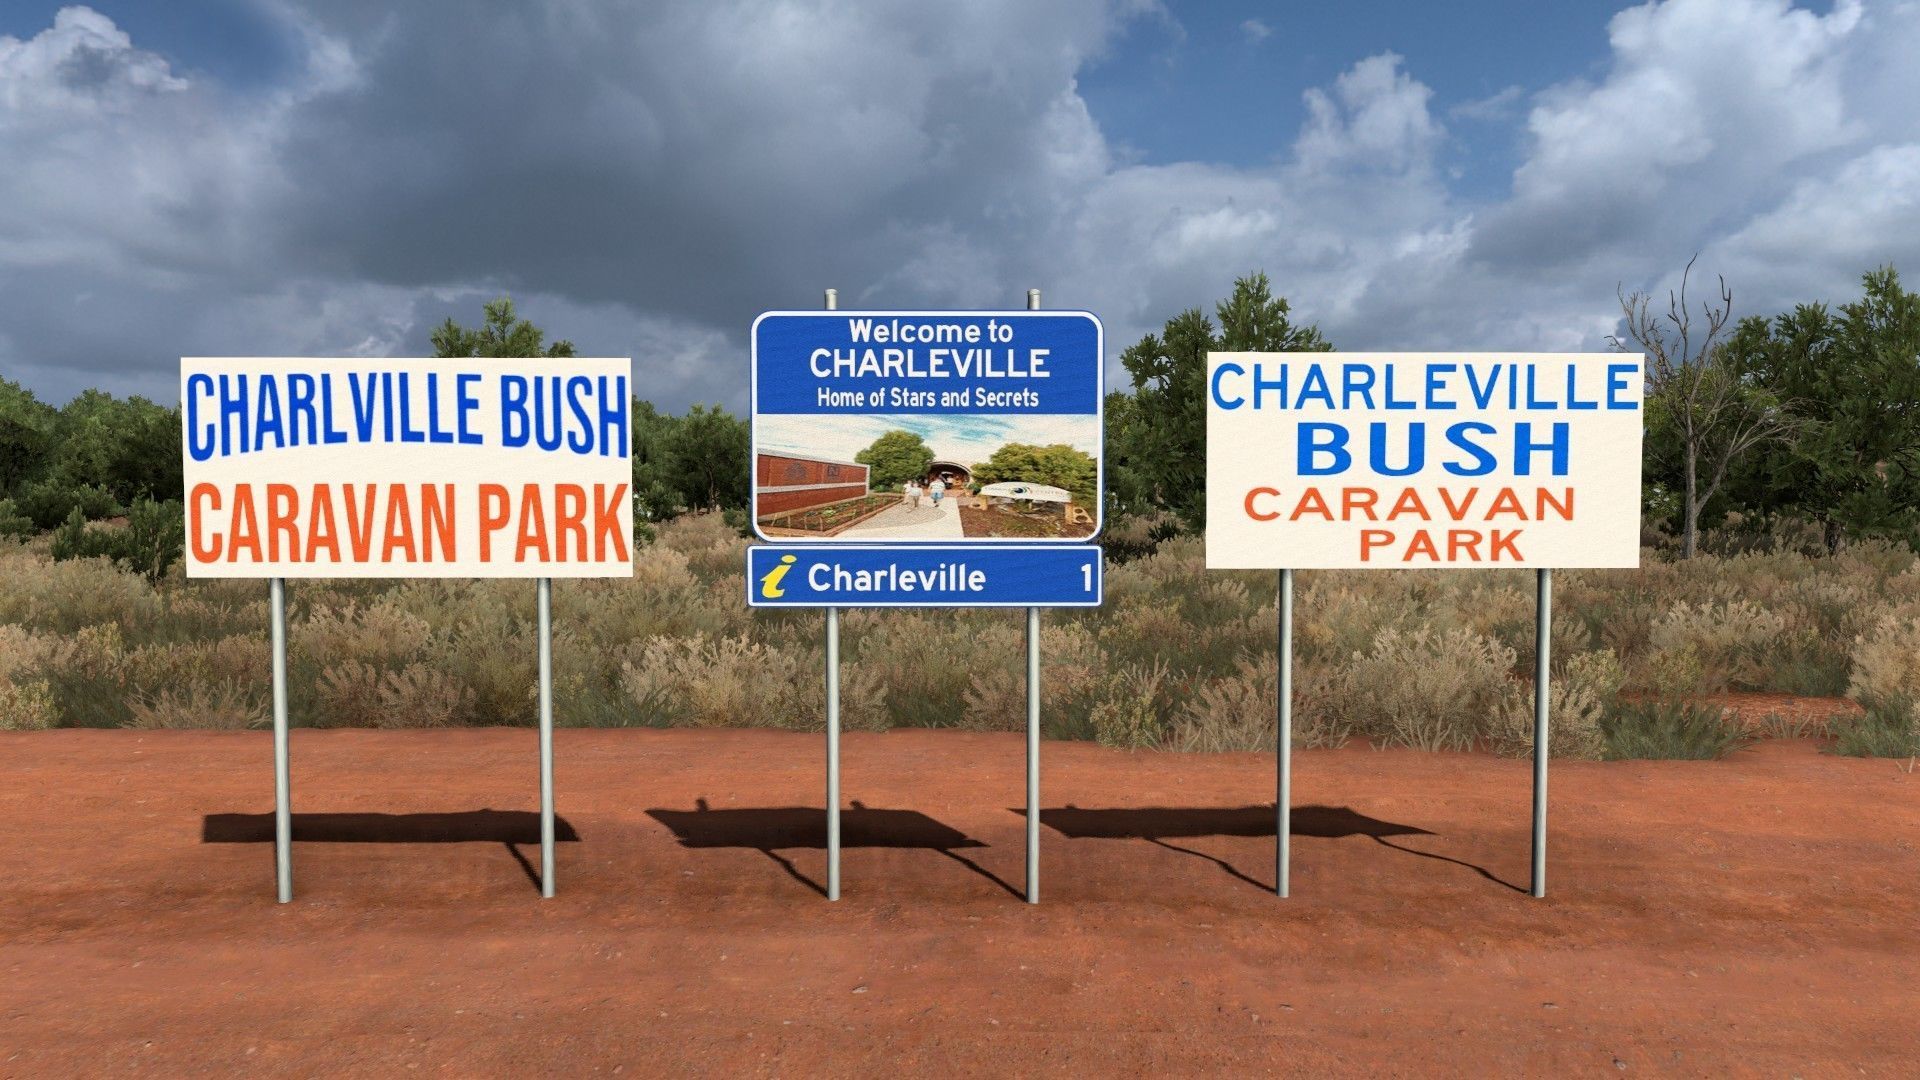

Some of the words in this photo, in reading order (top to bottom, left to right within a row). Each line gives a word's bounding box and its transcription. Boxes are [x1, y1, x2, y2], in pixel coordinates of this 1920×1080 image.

[849, 319, 980, 343] Welcome
[988, 319, 1013, 343] to
[810, 348, 1050, 378] CHARLEVILLE
[817, 387, 865, 407] Home
[869, 387, 886, 407] of
[890, 387, 936, 407] Stars
[940, 387, 970, 407] and
[975, 387, 1039, 407] Secrets
[1211, 363, 1639, 410] CHARLEVILLE
[187, 372, 483, 462] CHARLVILLE
[500, 375, 627, 458] BUSH
[1297, 421, 1570, 476] BUSH
[1244, 487, 1574, 521] CARAVAN
[190, 482, 456, 564] CARAVAN
[478, 483, 629, 562] PARK
[1360, 529, 1524, 561] PARK
[808, 563, 986, 592] Charleville
[1081, 563, 1092, 591] 1
